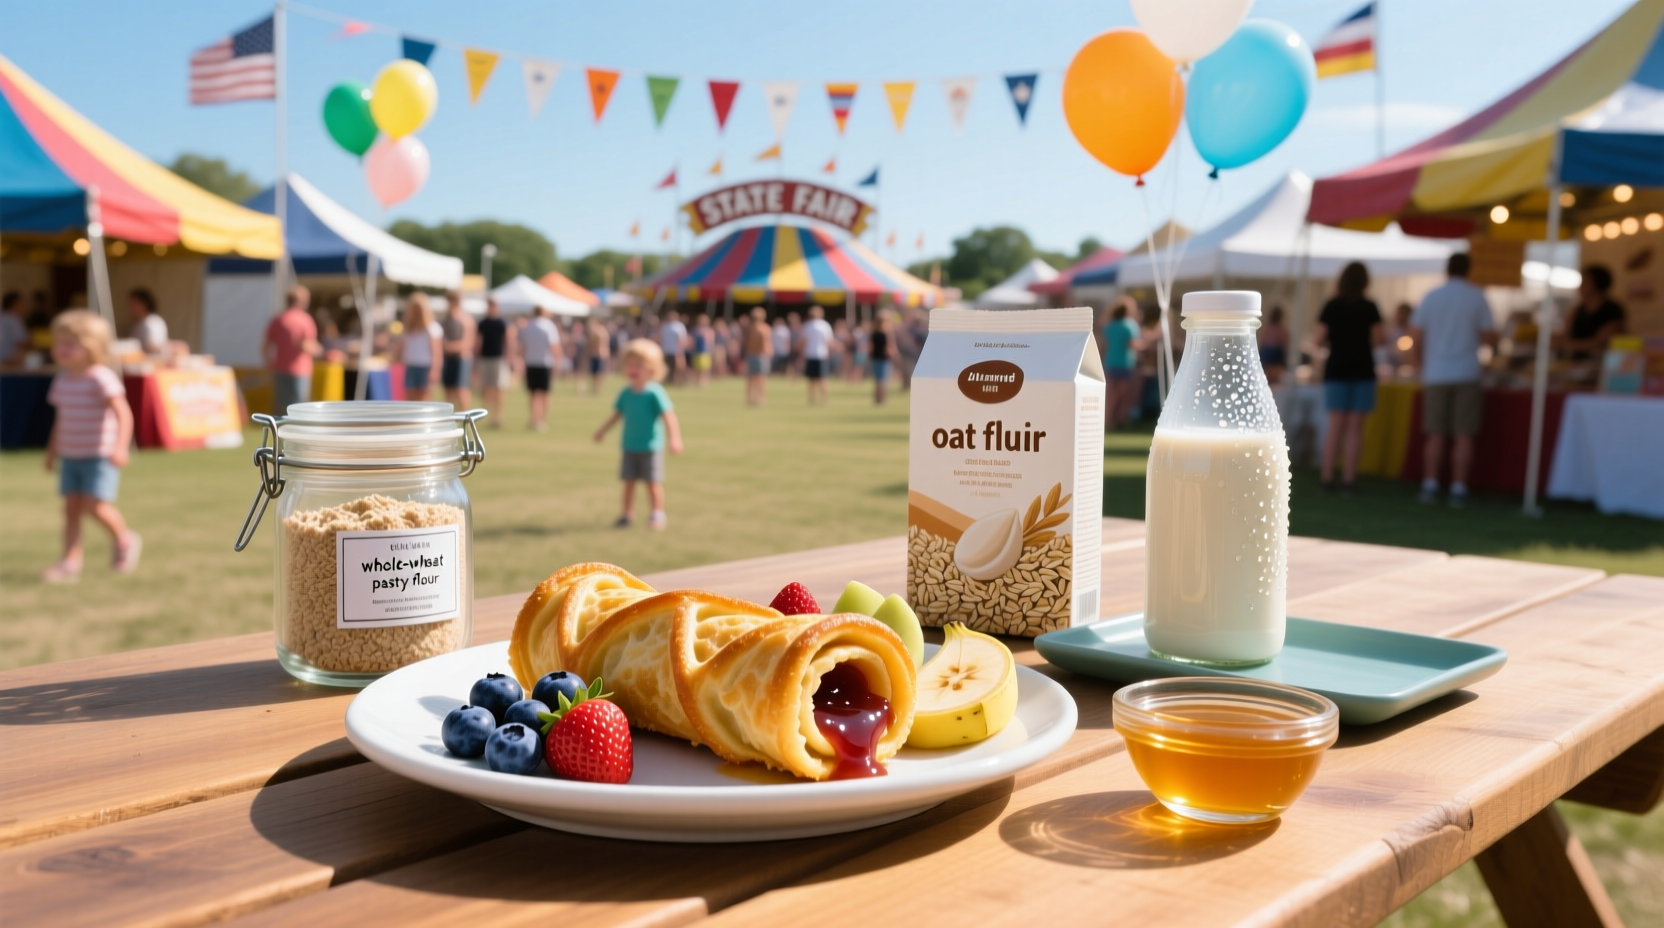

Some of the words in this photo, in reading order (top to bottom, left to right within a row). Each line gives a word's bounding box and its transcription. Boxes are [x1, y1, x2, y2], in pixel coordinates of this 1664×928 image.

[699, 182, 785, 227] STATE
[791, 184, 858, 227] FAIR
[932, 423, 976, 449] oat
[982, 420, 1047, 452] fluir
[372, 576, 409, 593] pasty
